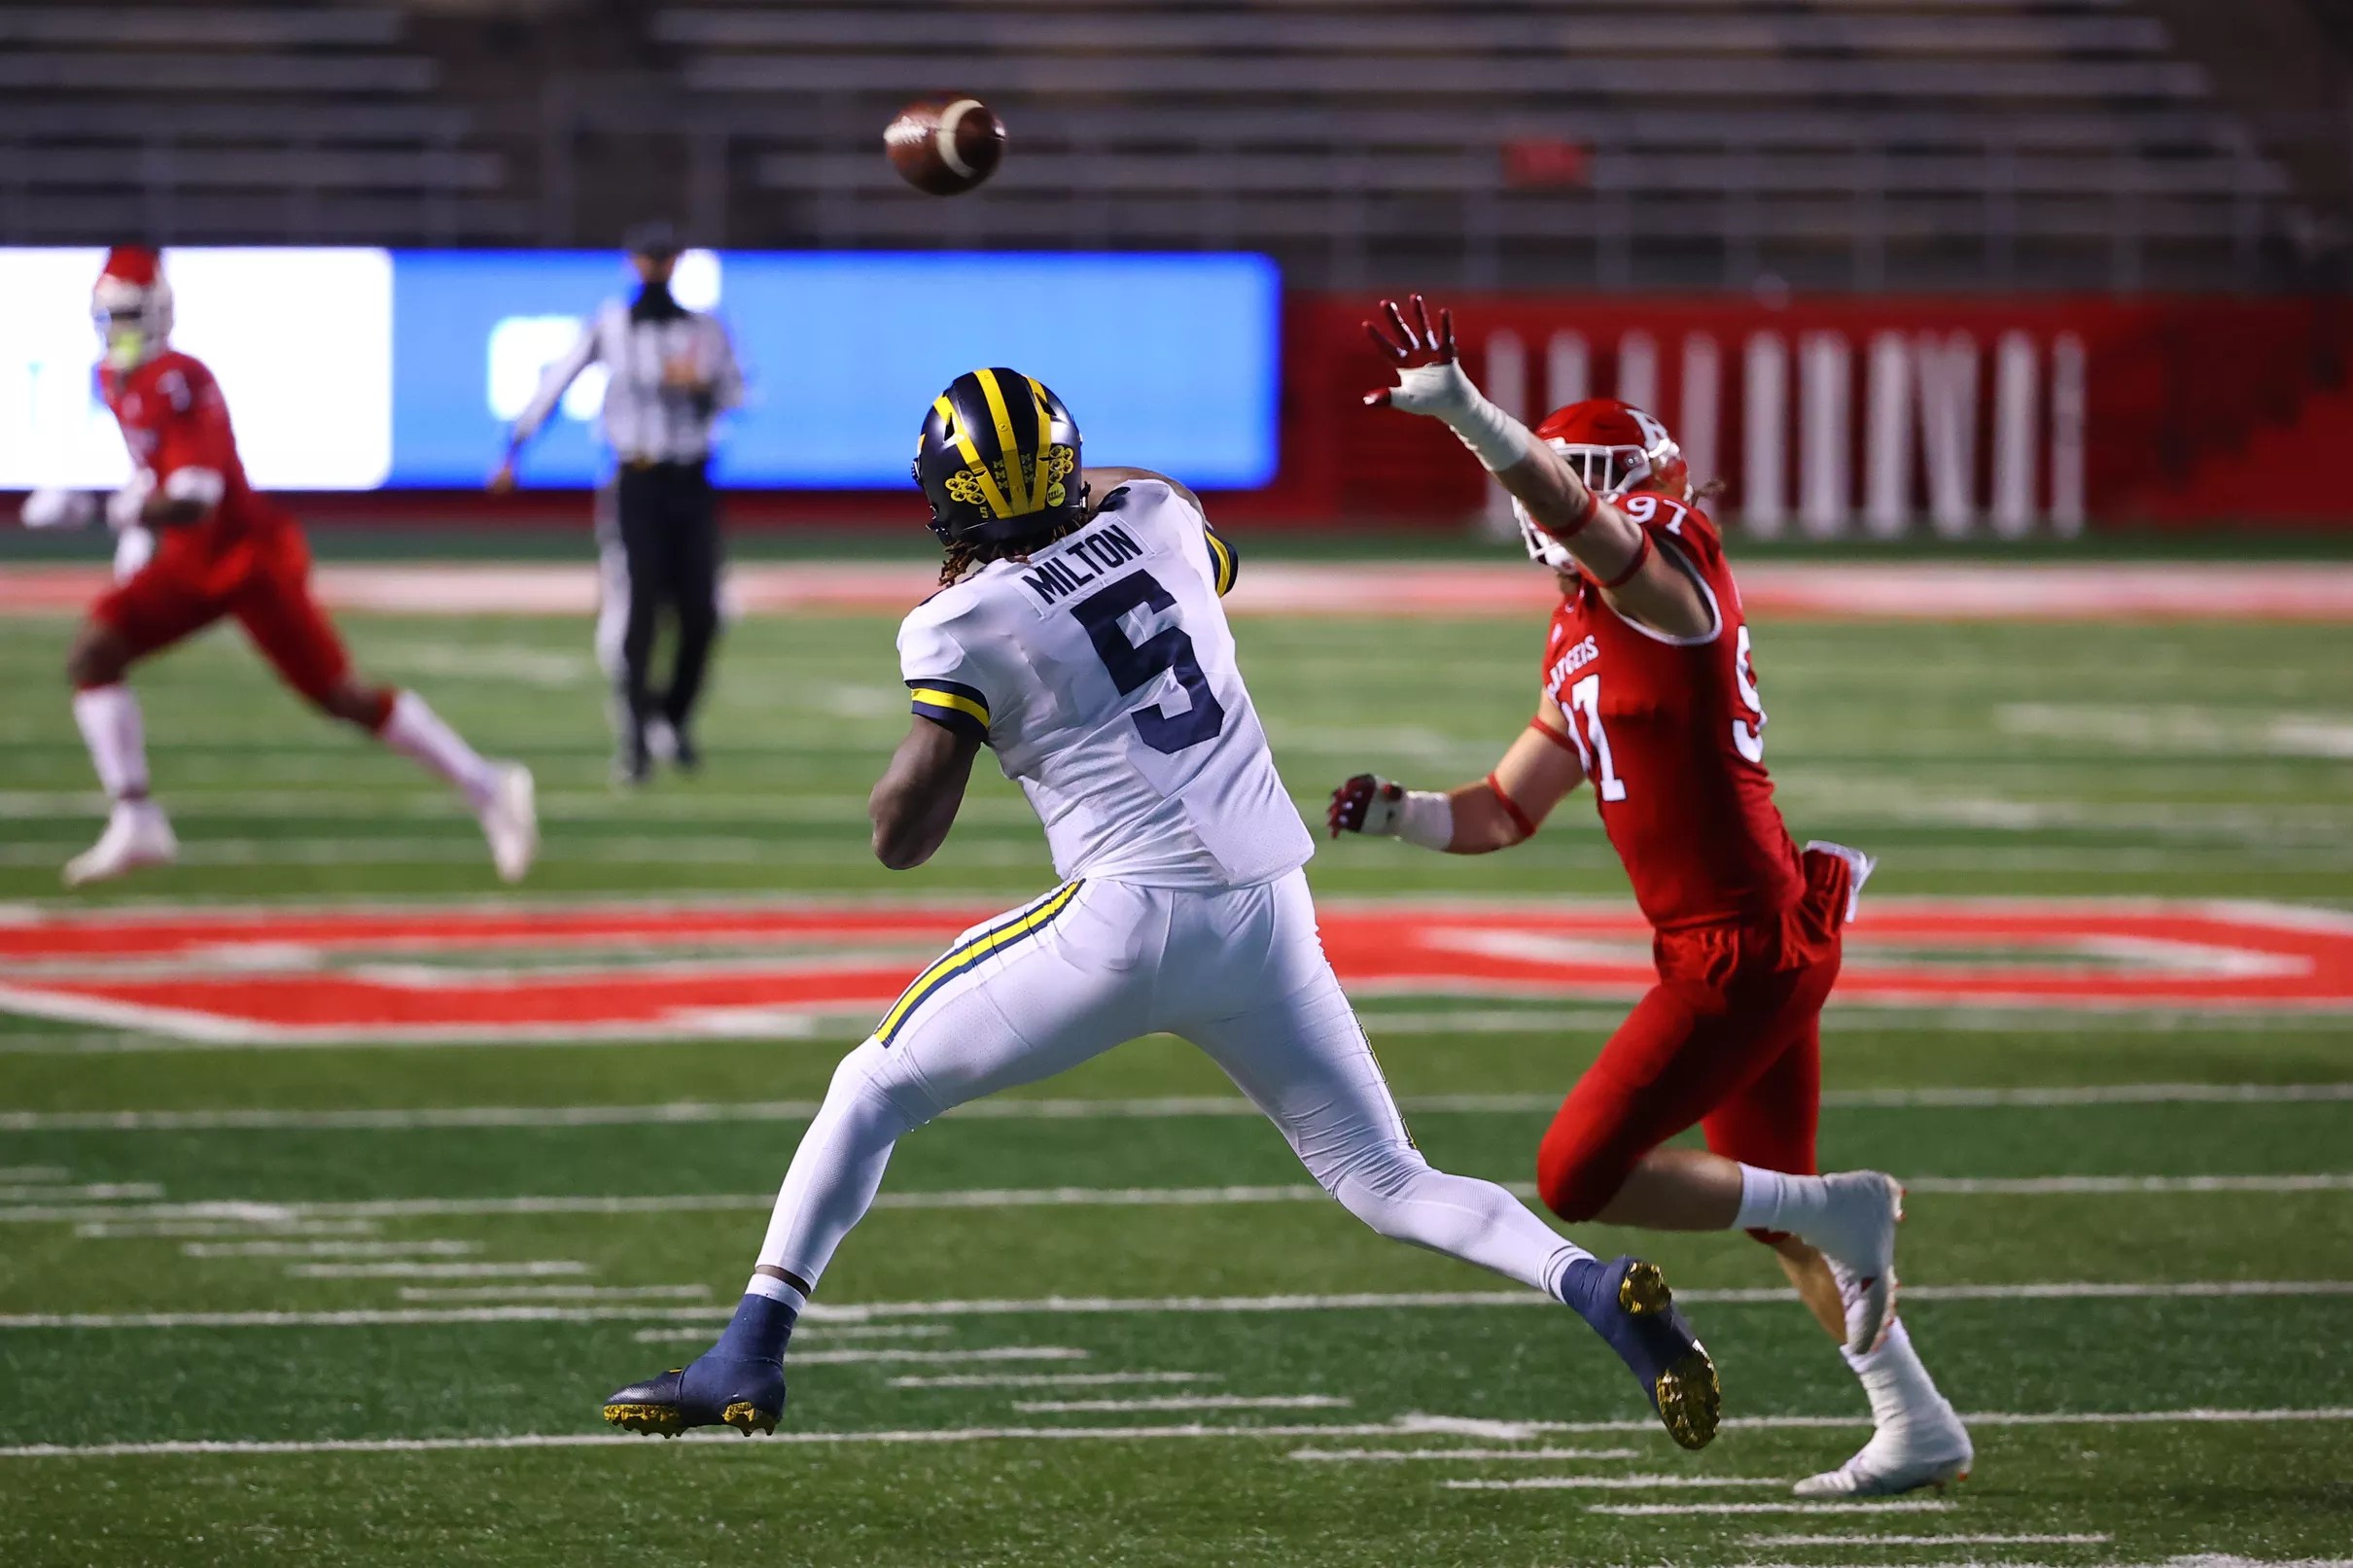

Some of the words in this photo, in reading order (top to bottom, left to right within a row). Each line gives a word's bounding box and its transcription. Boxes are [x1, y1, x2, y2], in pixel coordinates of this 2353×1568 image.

[979, 506, 989, 518] 5
[1626, 496, 1688, 535] 97
[1022, 525, 1142, 605] MILTON
[1070, 569, 1225, 754] 5
